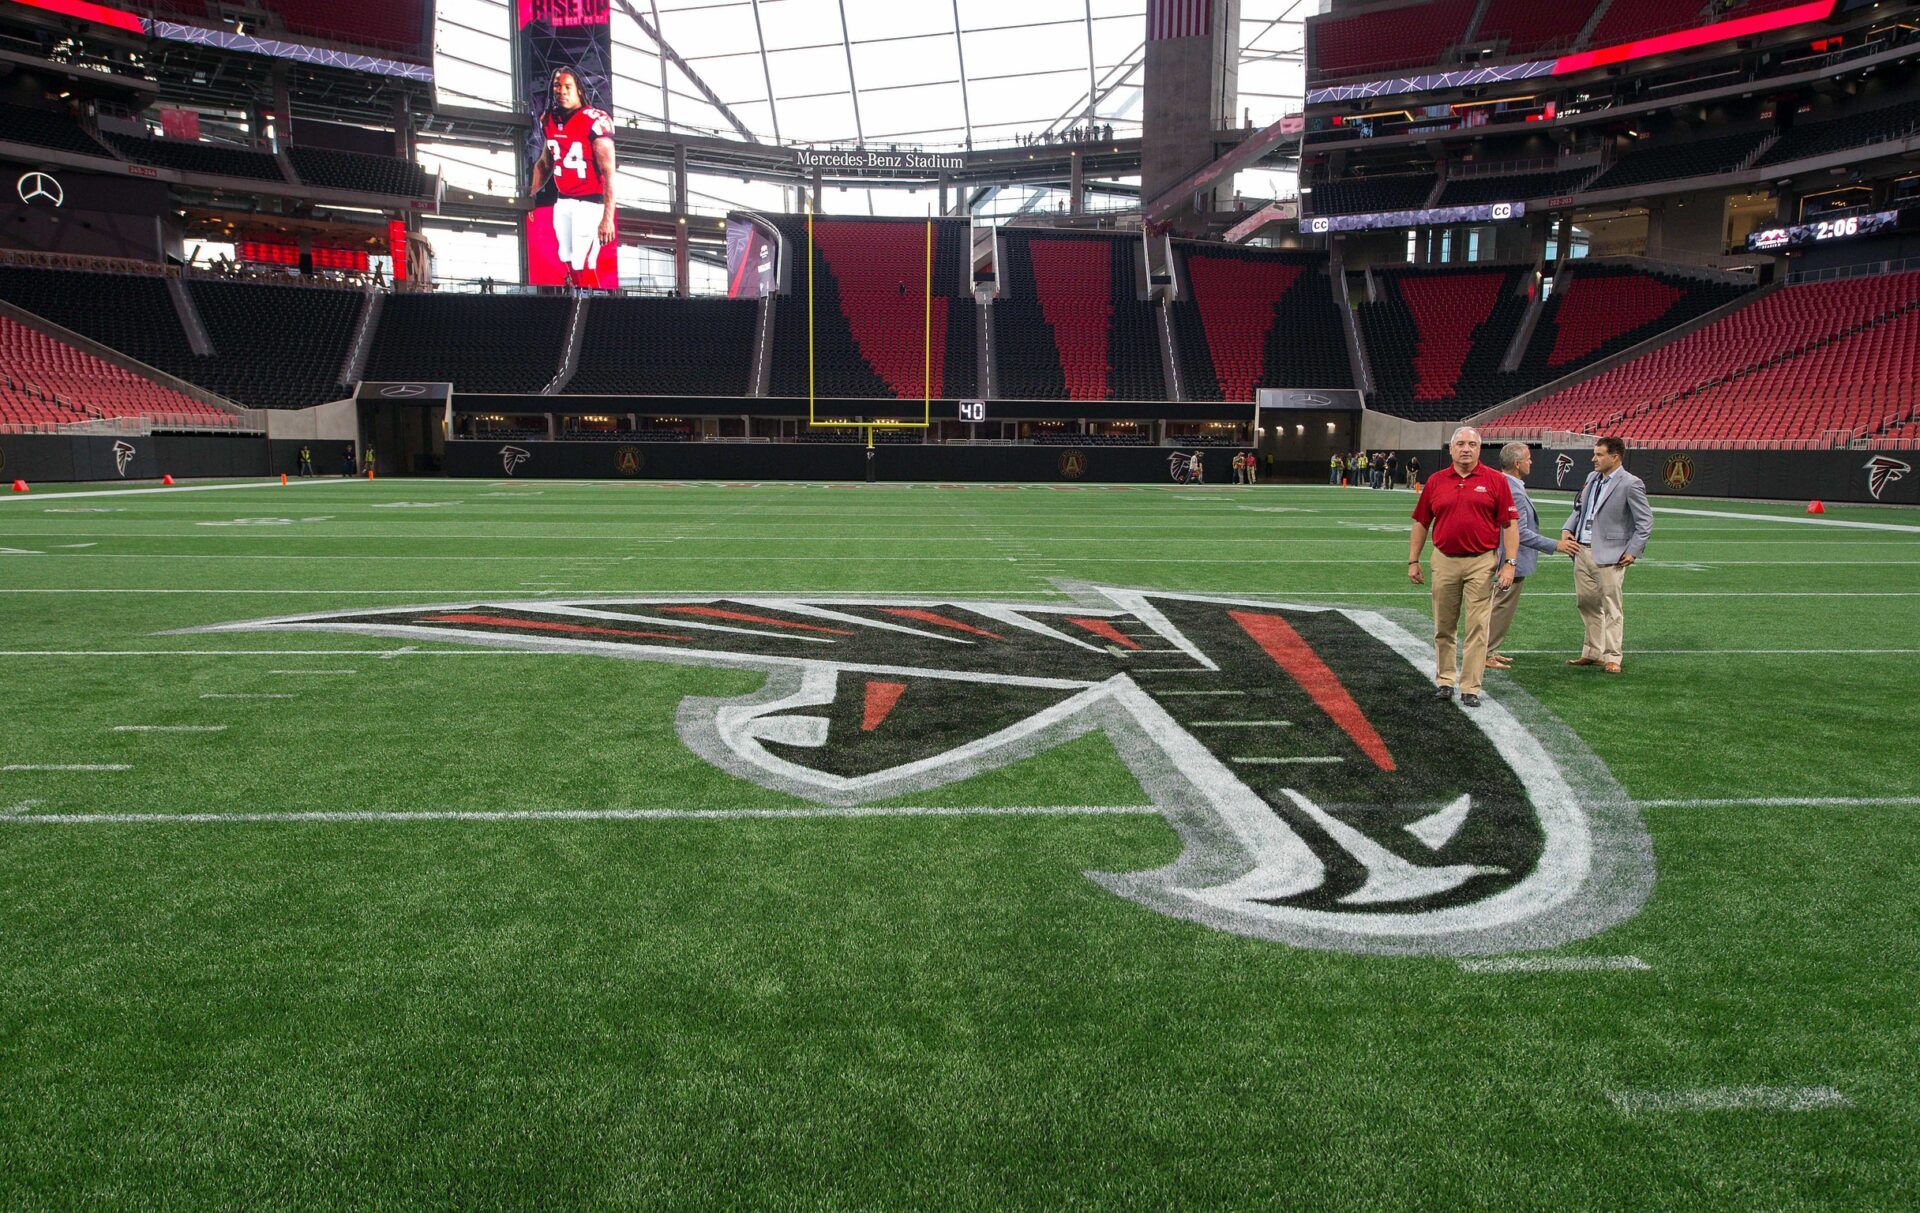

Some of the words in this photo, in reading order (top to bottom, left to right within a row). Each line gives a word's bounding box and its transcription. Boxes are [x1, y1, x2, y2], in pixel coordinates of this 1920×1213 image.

[532, 0, 581, 20] RISE
[582, 0, 609, 17] UP
[797, 151, 901, 168] Mercedes-Benz
[905, 153, 963, 169] Stadium
[1494, 206, 1509, 216] CC
[1313, 220, 1328, 230] CC
[1816, 216, 1858, 240] 2:06
[961, 403, 983, 420] 40
